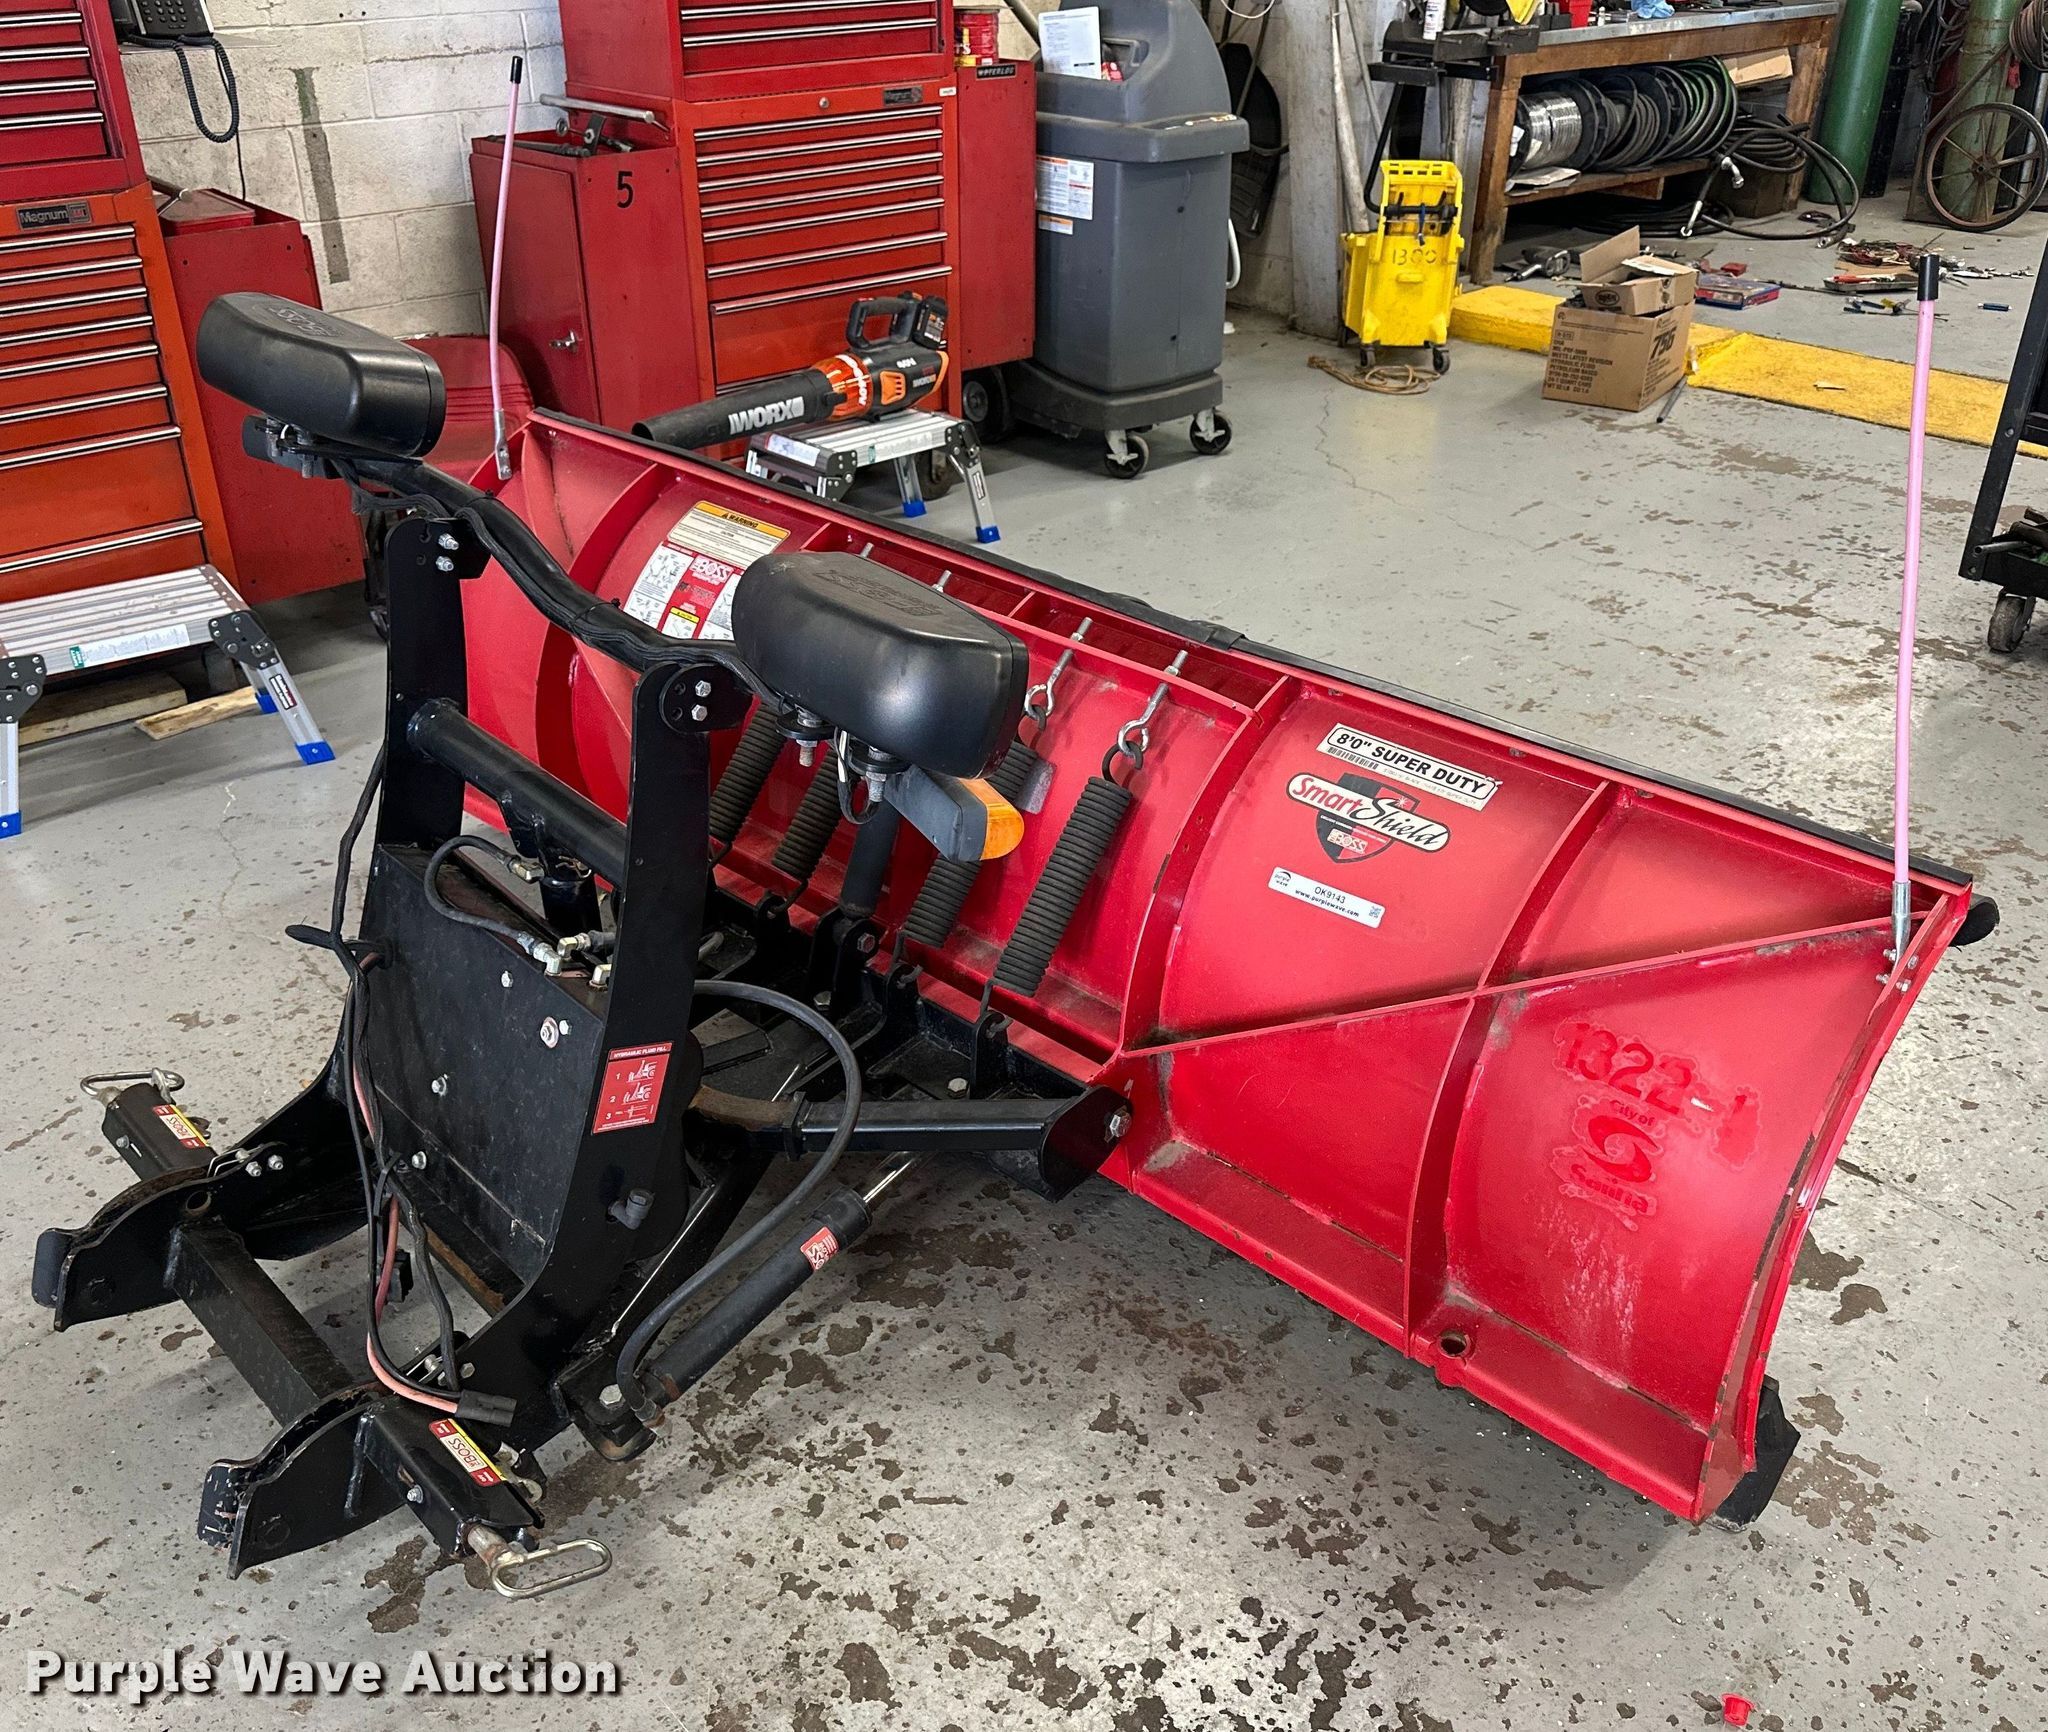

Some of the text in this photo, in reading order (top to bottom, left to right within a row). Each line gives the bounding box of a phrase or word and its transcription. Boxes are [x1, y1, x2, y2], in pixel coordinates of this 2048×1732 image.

[617, 170, 634, 209] 5
[20, 209, 68, 224] Magnum
[728, 399, 797, 435] WORX
[698, 557, 734, 583] BOSS
[1371, 746, 1432, 776] SUPER
[1432, 767, 1487, 794] DUTY
[1334, 832, 1367, 852] BOSS
[1295, 889, 1360, 917] www.purplewave.com
[1314, 886, 1346, 904] OK9143
[609, 1095, 616, 1103] 2
[605, 1112, 612, 1120] 3
[447, 1437, 477, 1464] BOSS
